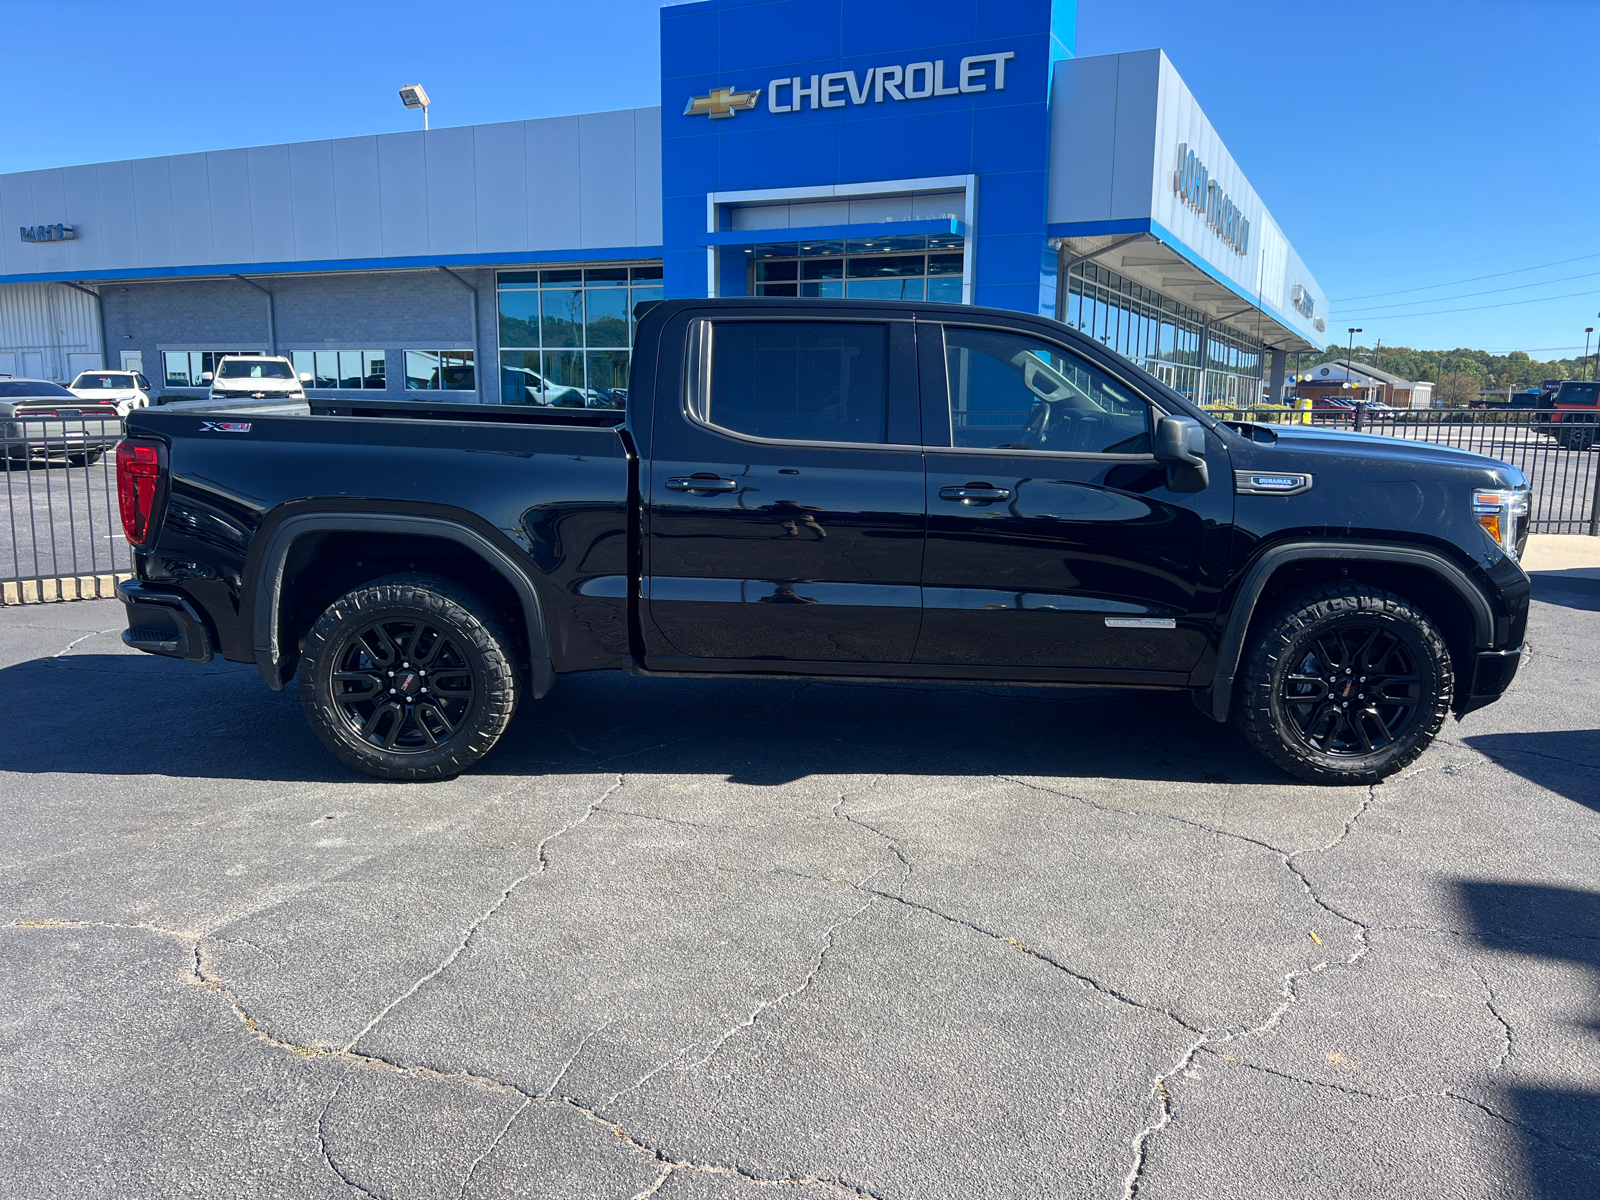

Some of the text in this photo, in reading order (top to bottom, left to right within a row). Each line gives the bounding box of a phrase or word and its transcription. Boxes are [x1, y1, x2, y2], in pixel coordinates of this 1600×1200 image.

[768, 51, 1015, 114] CHEVROLET
[1174, 143, 1208, 214] JOHN
[20, 223, 66, 242] PARTS
